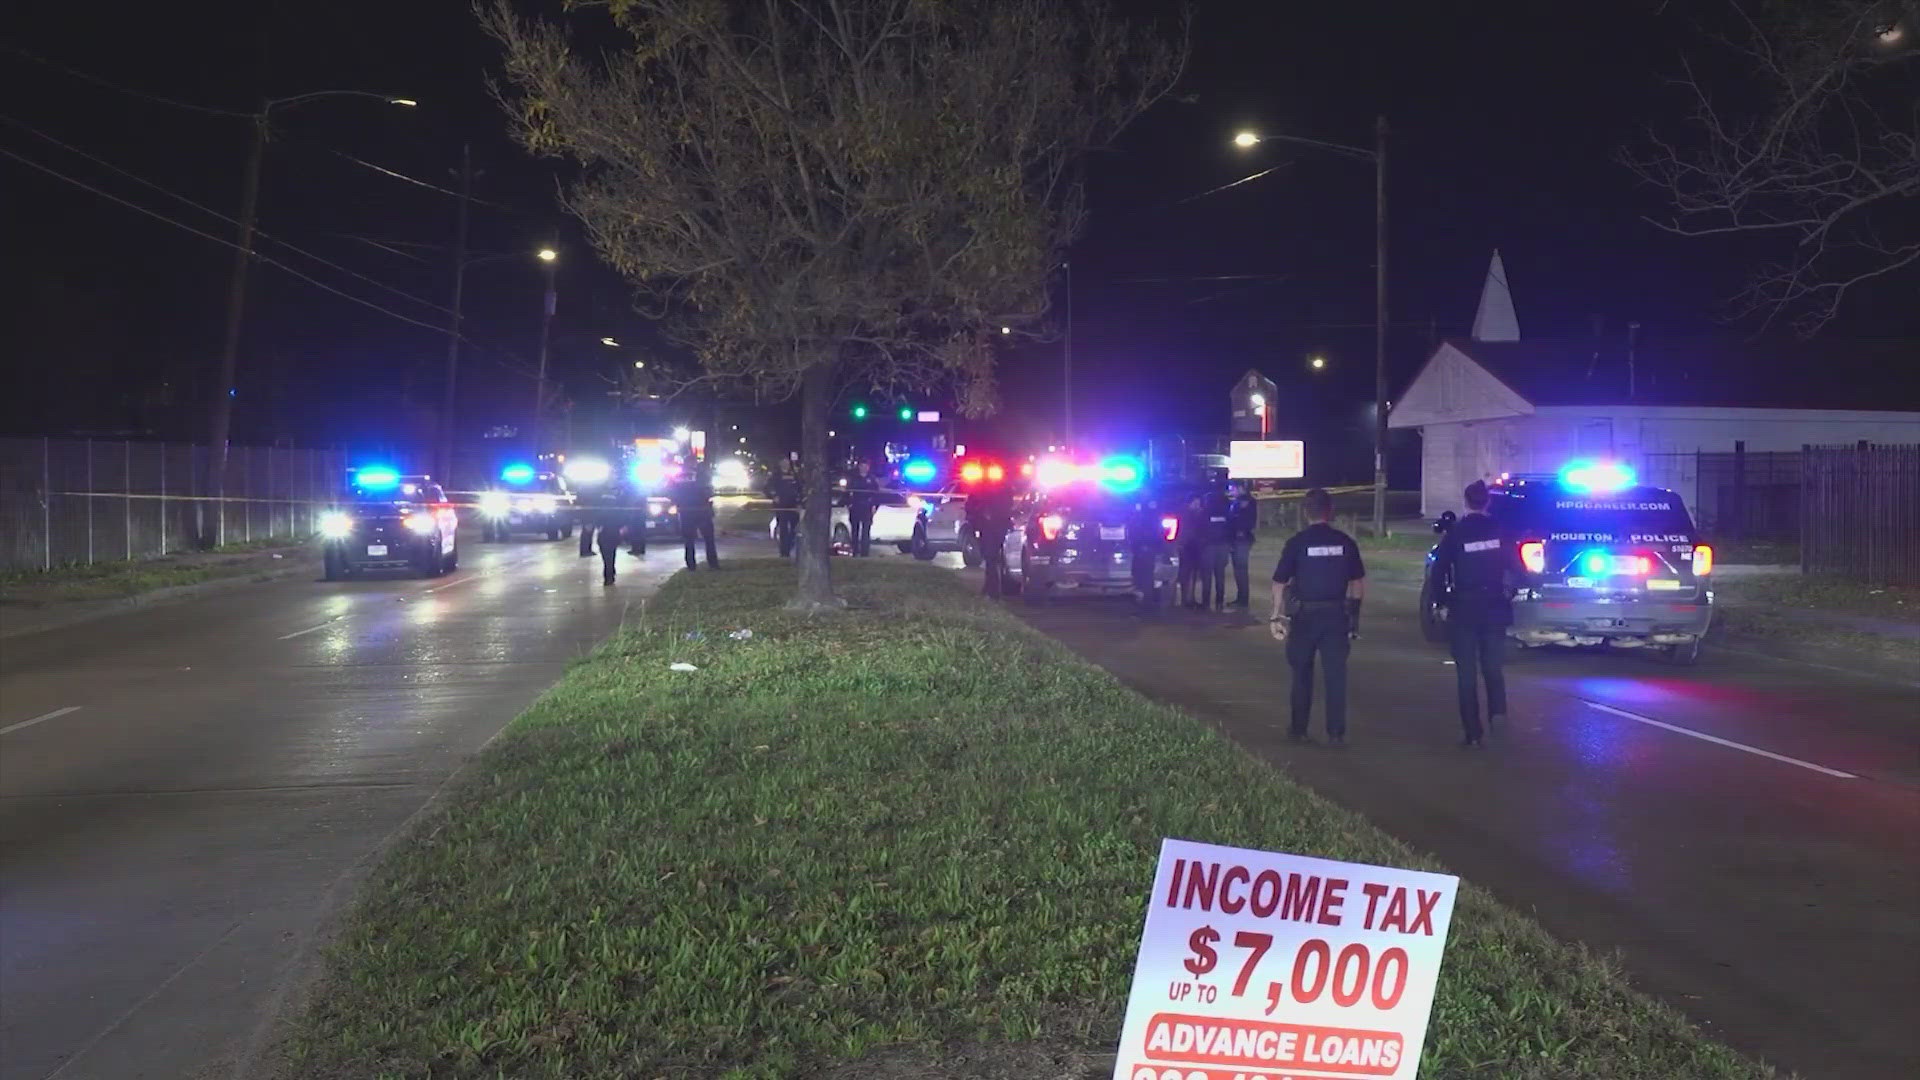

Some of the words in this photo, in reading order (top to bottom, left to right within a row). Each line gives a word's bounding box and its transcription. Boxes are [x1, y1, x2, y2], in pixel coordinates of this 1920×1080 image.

[1551, 532, 1612, 542] HOUSTON
[1630, 533, 1689, 543] POLICE
[1167, 858, 1349, 926] INCOME
[1362, 882, 1442, 936] TAX
[1169, 981, 1190, 1002] UP
[1198, 984, 1217, 1004] TO
[1148, 1022, 1297, 1061] ADVANCE
[1303, 1034, 1400, 1067] LOANS
